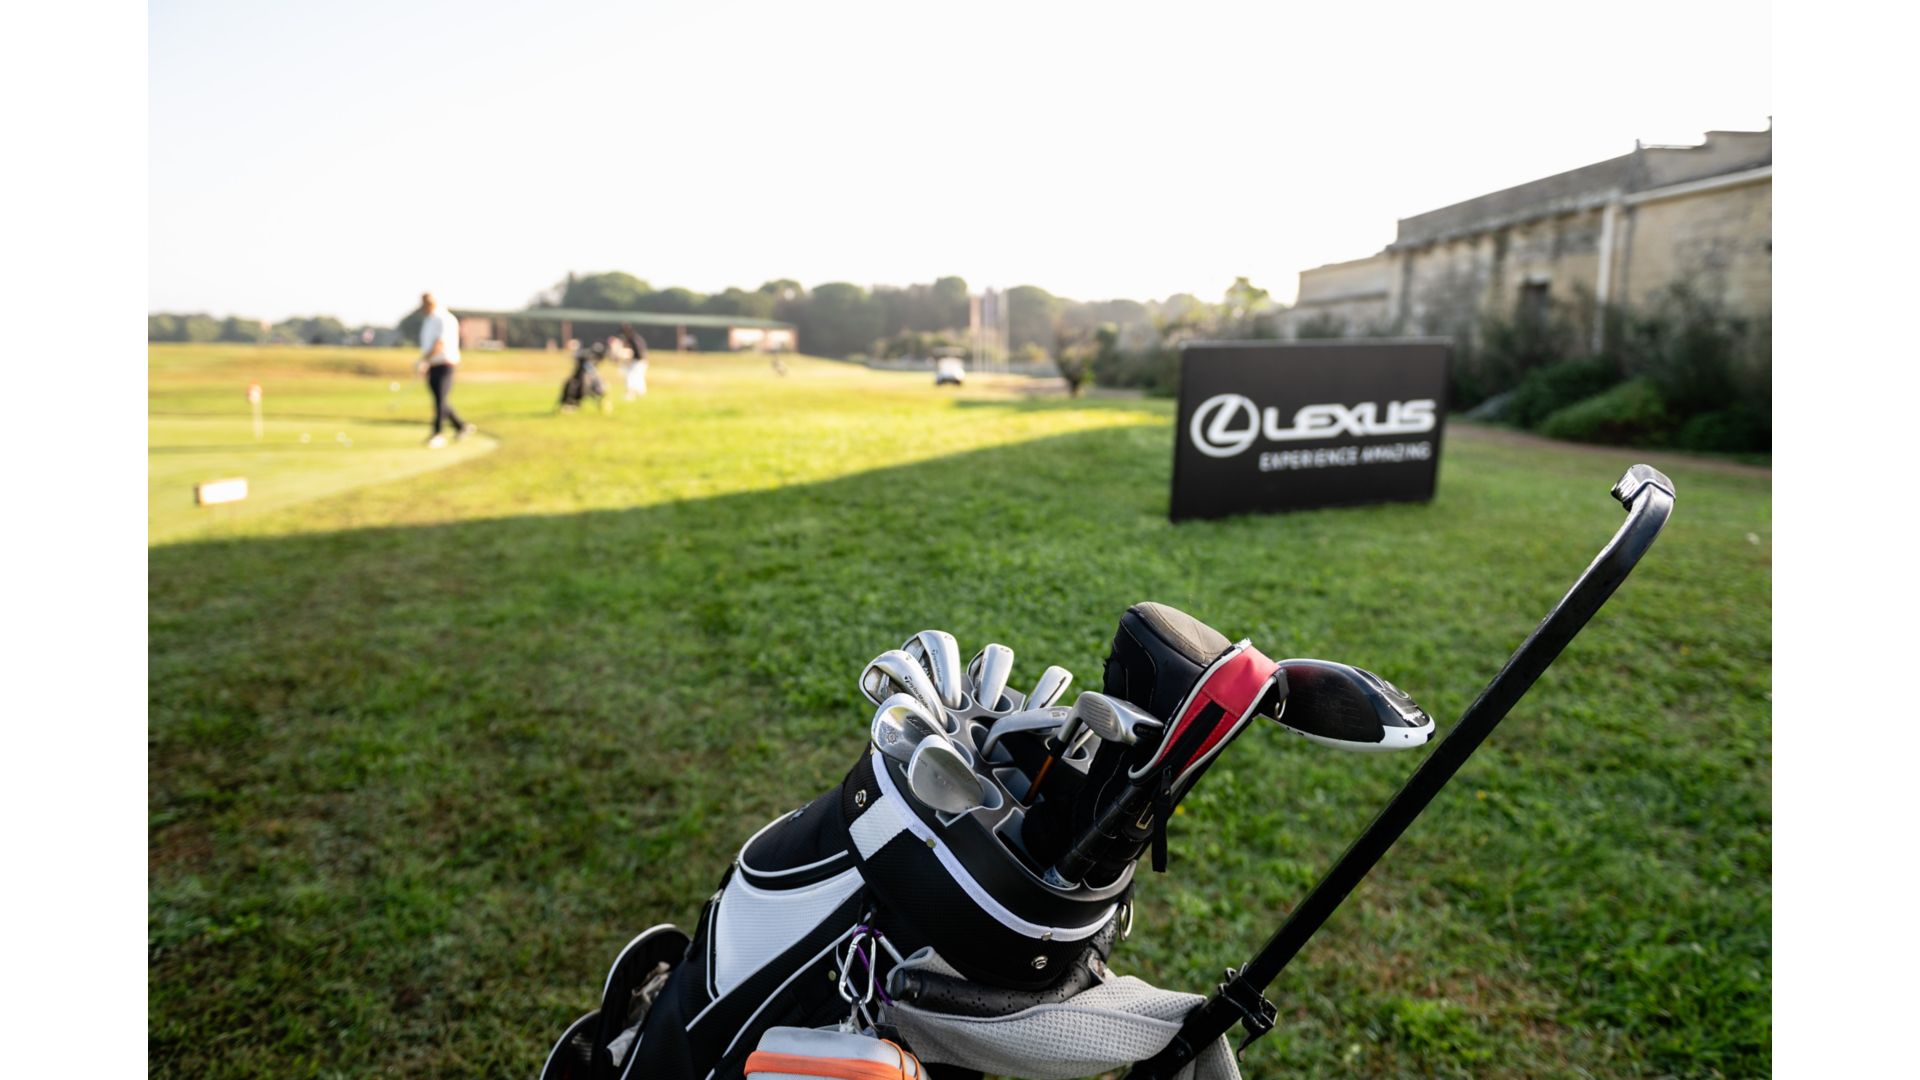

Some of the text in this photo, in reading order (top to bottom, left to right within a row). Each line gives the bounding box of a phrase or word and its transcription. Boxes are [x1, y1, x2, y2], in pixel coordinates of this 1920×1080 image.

[1262, 399, 1437, 441] LEXUS
[1259, 441, 1431, 471] EXPERIENCE AMAZING
